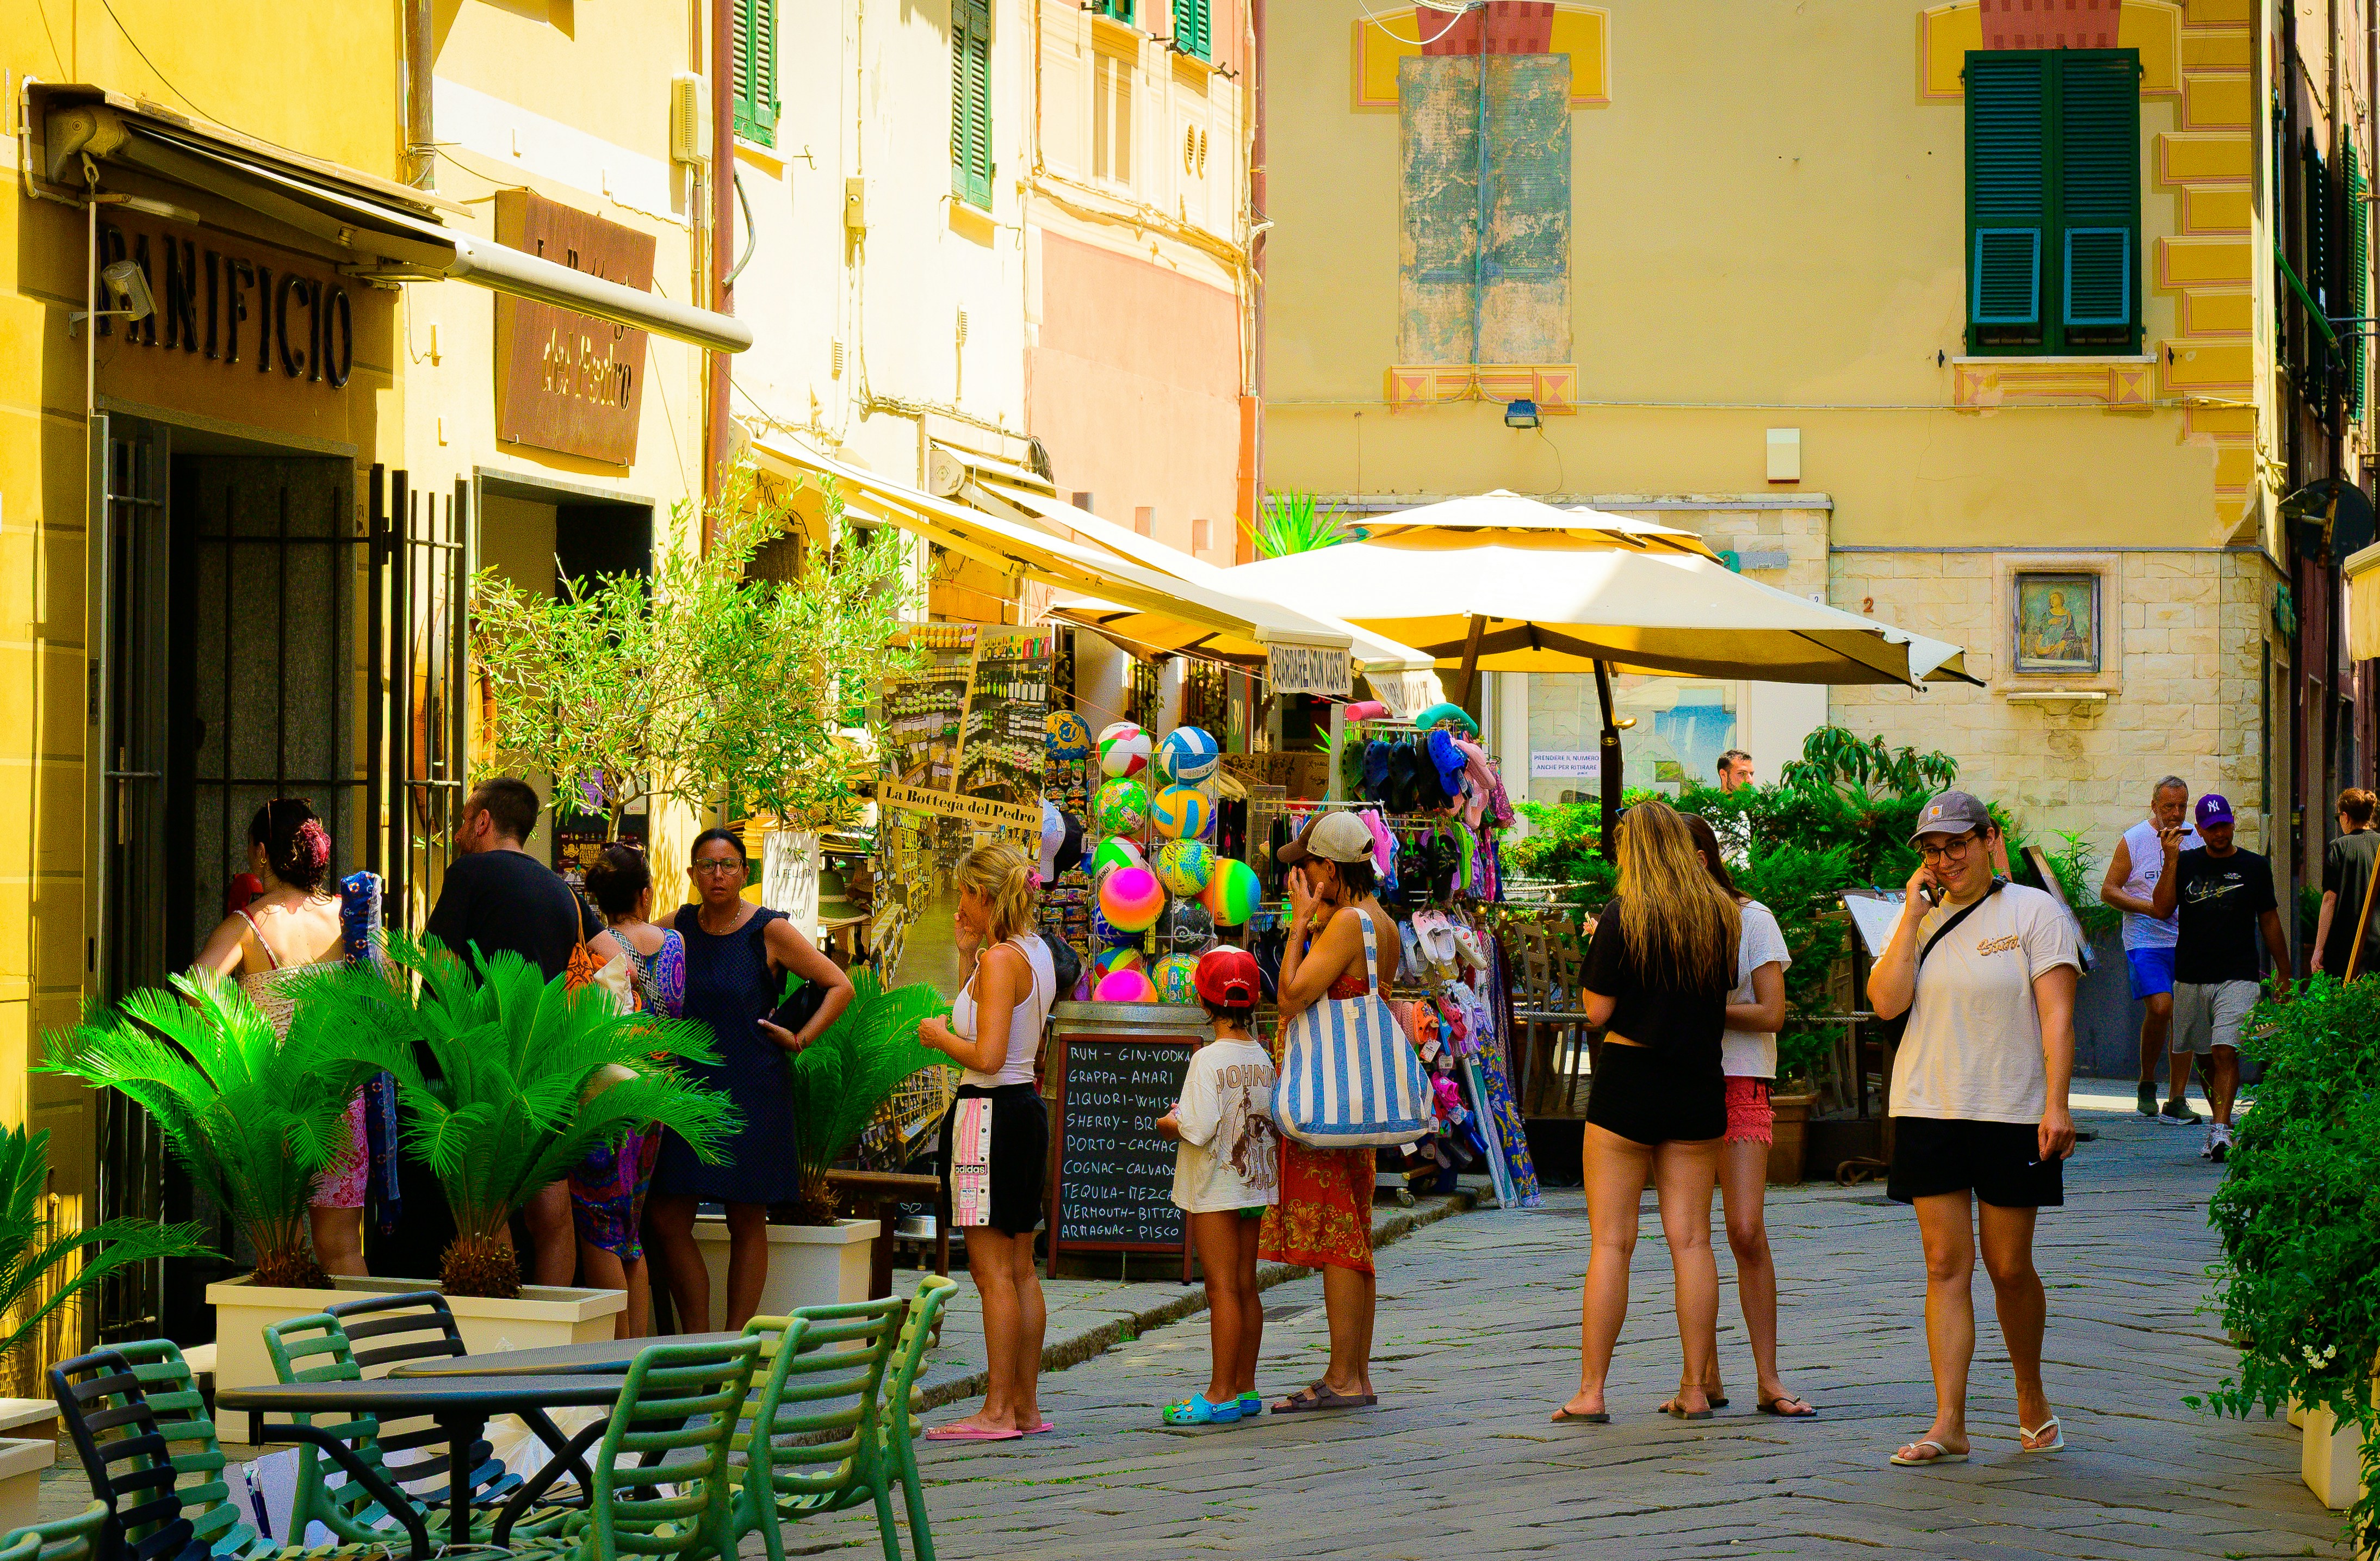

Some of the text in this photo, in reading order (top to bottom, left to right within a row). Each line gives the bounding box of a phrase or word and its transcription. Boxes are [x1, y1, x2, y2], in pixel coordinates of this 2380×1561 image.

[95, 222, 353, 389] PANIFICIO
[541, 327, 632, 412] del Pedro
[1863, 597, 1874, 613] 2
[1271, 646, 1348, 690] GUARDARE NON COSTA
[885, 786, 1036, 823] La Bottega del Pedro
[771, 869, 780, 879] LA
[1070, 1047, 1097, 1061] RUM
[955, 1165, 985, 1174] adidas
[1139, 1225, 1179, 1239] PISCO
